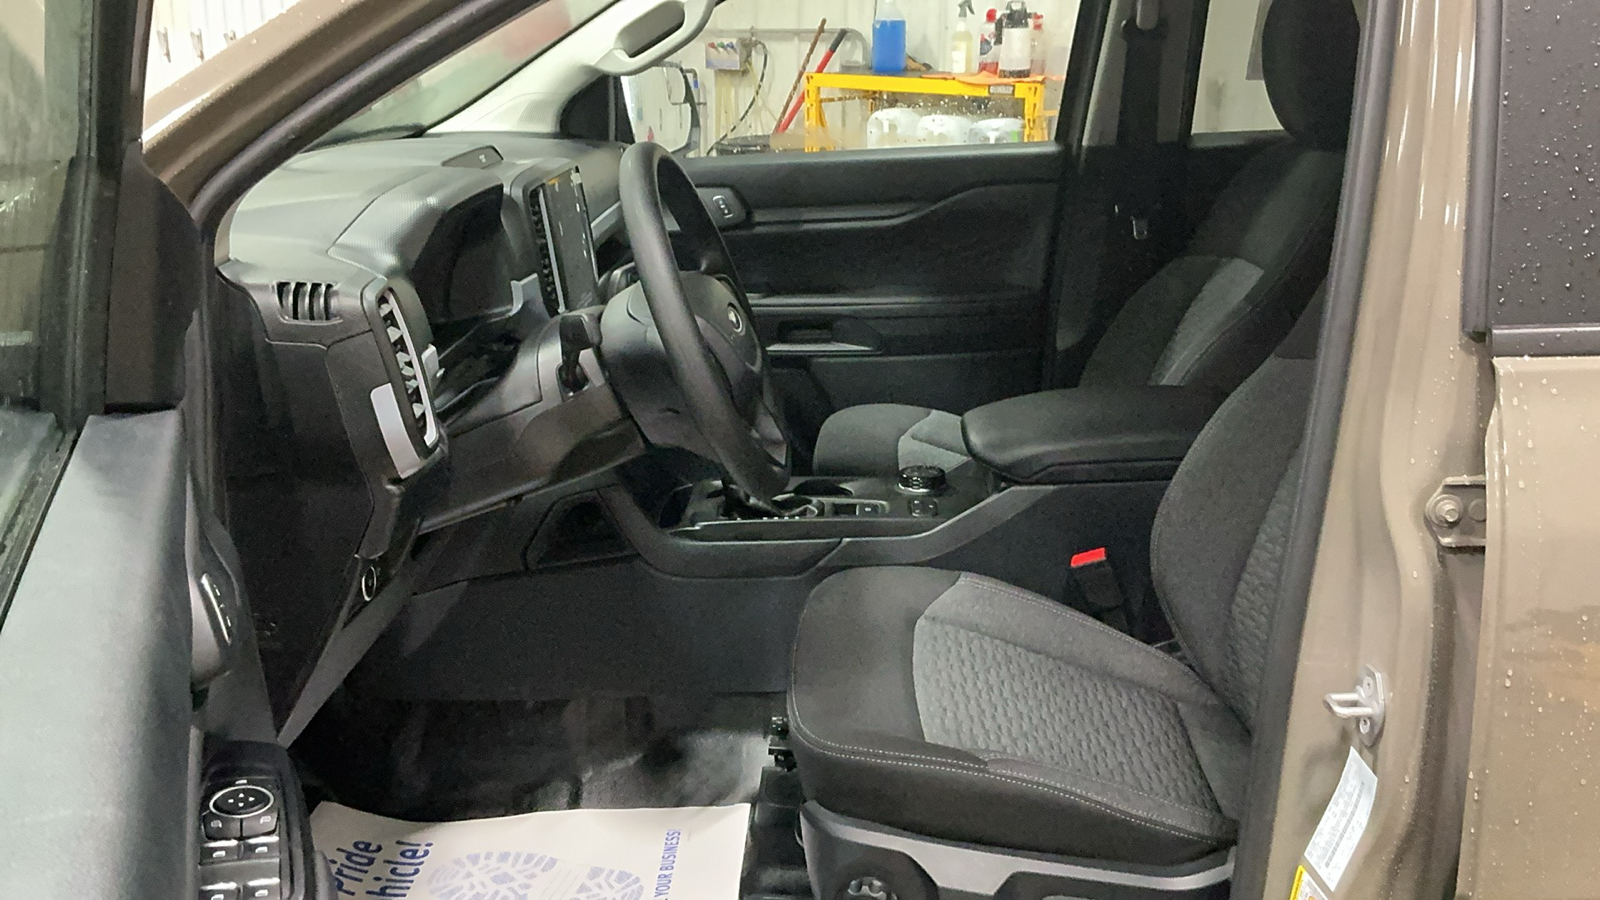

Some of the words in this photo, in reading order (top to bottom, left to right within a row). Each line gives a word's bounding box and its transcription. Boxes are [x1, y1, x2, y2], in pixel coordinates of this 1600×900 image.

[365, 840, 434, 900] hicle!
[659, 828, 682, 871] BUSINESS!
[654, 873, 673, 898] YOUR
